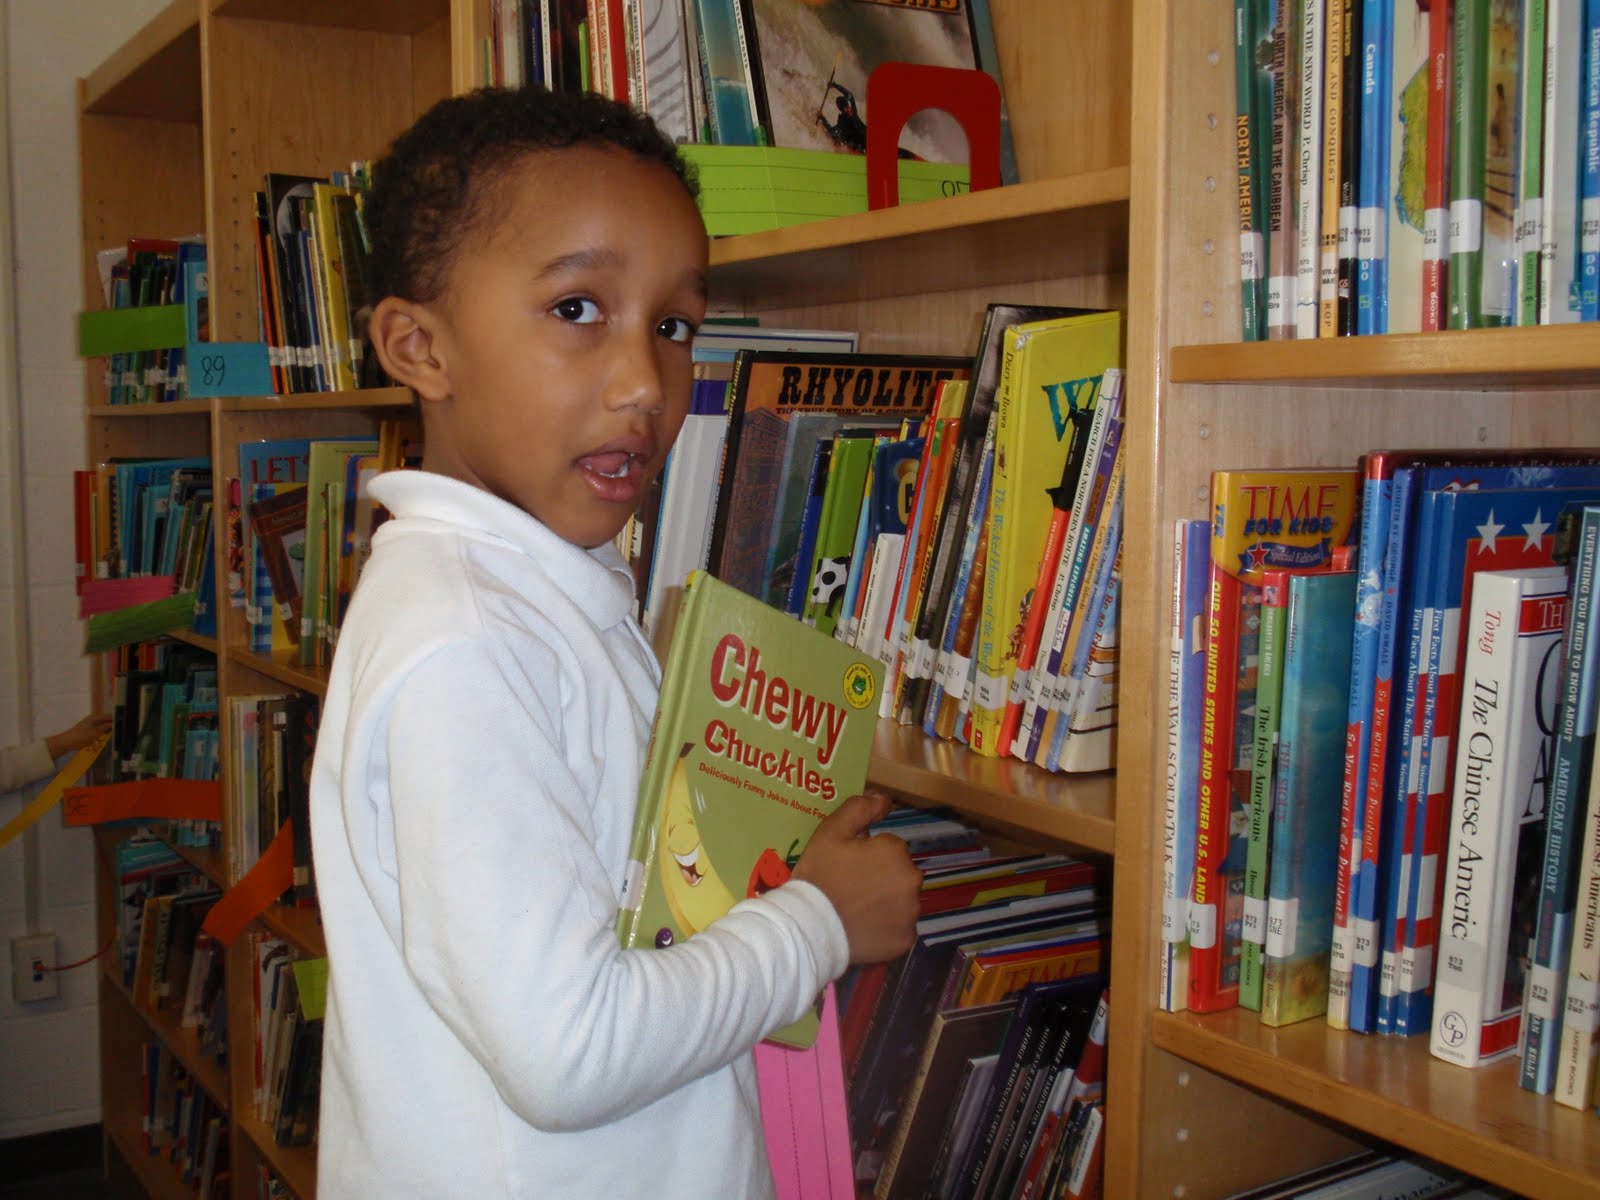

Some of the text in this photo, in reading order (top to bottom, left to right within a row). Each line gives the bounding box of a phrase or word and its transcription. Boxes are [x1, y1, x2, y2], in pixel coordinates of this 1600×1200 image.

[1306, 12, 1315, 27] IN
[740, 34, 749, 69] SPORTS
[1275, 32, 1286, 68] NORTH
[1305, 29, 1314, 53] THE
[1304, 56, 1313, 83] NEW
[1365, 43, 1376, 95] Canada
[1273, 73, 1285, 120] AMERICA
[1329, 74, 1338, 101] AND
[1303, 86, 1313, 130] WORLD
[1273, 125, 1283, 145] AND
[1328, 108, 1337, 182] CONQUEST
[1587, 110, 1600, 174] Republic
[1237, 115, 1253, 231] NORTH AMERIC
[1272, 150, 1283, 168] THE
[1301, 150, 1311, 186] Chrisp
[1271, 174, 1282, 232] CARIBBEAN
[202, 355, 226, 387] 89
[1001, 352, 1014, 428] Deary Brown
[1089, 406, 1104, 447] SEARCH
[1085, 448, 1097, 469] FOR
[994, 488, 1006, 509] The
[1106, 475, 1120, 506] PEOPLE
[1240, 485, 1341, 524] TIME
[1070, 478, 1089, 536] NORTHERN
[1214, 504, 1226, 539] TFK
[990, 515, 1004, 554] Wicked
[1243, 516, 1335, 537] FOR KIDS
[1062, 535, 1076, 567] ROUTE
[1065, 527, 1091, 607] AMAZING EXPLORERS
[1269, 550, 1322, 563] Special Edition
[1389, 542, 1399, 582] GEORGE
[1581, 525, 1597, 593] EVERYTHING
[988, 556, 1000, 601] History
[985, 604, 994, 618] of
[1052, 583, 1065, 611] Chrisp
[1103, 595, 1114, 610] Be
[1578, 596, 1589, 619] YOU
[983, 619, 993, 637] the
[1098, 613, 1106, 628] an
[1385, 600, 1394, 630] DAVID
[1413, 609, 1423, 630] First
[1434, 609, 1443, 631] First
[1539, 600, 1564, 629] TH
[1410, 635, 1420, 660] Facts
[1431, 635, 1440, 660] Facts
[1573, 622, 1586, 651] NEED
[1263, 652, 1273, 677] AMERICA
[1407, 662, 1418, 692] About
[1427, 662, 1438, 693] About
[1571, 654, 1582, 669] TO
[710, 633, 848, 769] Chewy
[1351, 671, 1360, 708] SMALL
[1378, 690, 1386, 702] So
[1567, 671, 1580, 705] KNOW
[1375, 708, 1385, 727] You
[1405, 696, 1415, 715] The
[1425, 697, 1435, 716] The
[1402, 718, 1413, 746] States
[1422, 719, 1433, 747] States
[1564, 706, 1576, 743] ABOUT
[1164, 650, 1181, 862] IF THE WALLS COULD TALK
[1195, 580, 1223, 904] OUR 50 UNITED STATES AND OTHER U.S. LAND
[1373, 732, 1383, 758] Want
[704, 719, 837, 802] Chuckles
[1252, 706, 1271, 842] The Irish Americans
[1451, 611, 1501, 941] Tong The Chinese Americ
[699, 762, 830, 822] Deliciously Funny Jokes About Foo
[1553, 757, 1572, 832] AMERICAN
[1335, 733, 1357, 920] So You Want to Be President?
[1365, 797, 1378, 853] President?
[1546, 834, 1562, 894] HISTORY
[1583, 869, 1600, 950] Americans
[1268, 917, 1283, 935] 973 SNE
[1449, 956, 1464, 965] 973
[1056, 1029, 1072, 1064] BOOKER
[1525, 1048, 1538, 1080] KELLY
[1568, 1065, 1577, 1095] BOOKS
[987, 1026, 1033, 1146] GEORGE WASHINGTON CARVER
[1020, 1073, 1033, 1104] TRUTH
[1031, 1074, 1055, 1127] WASHINGTON
